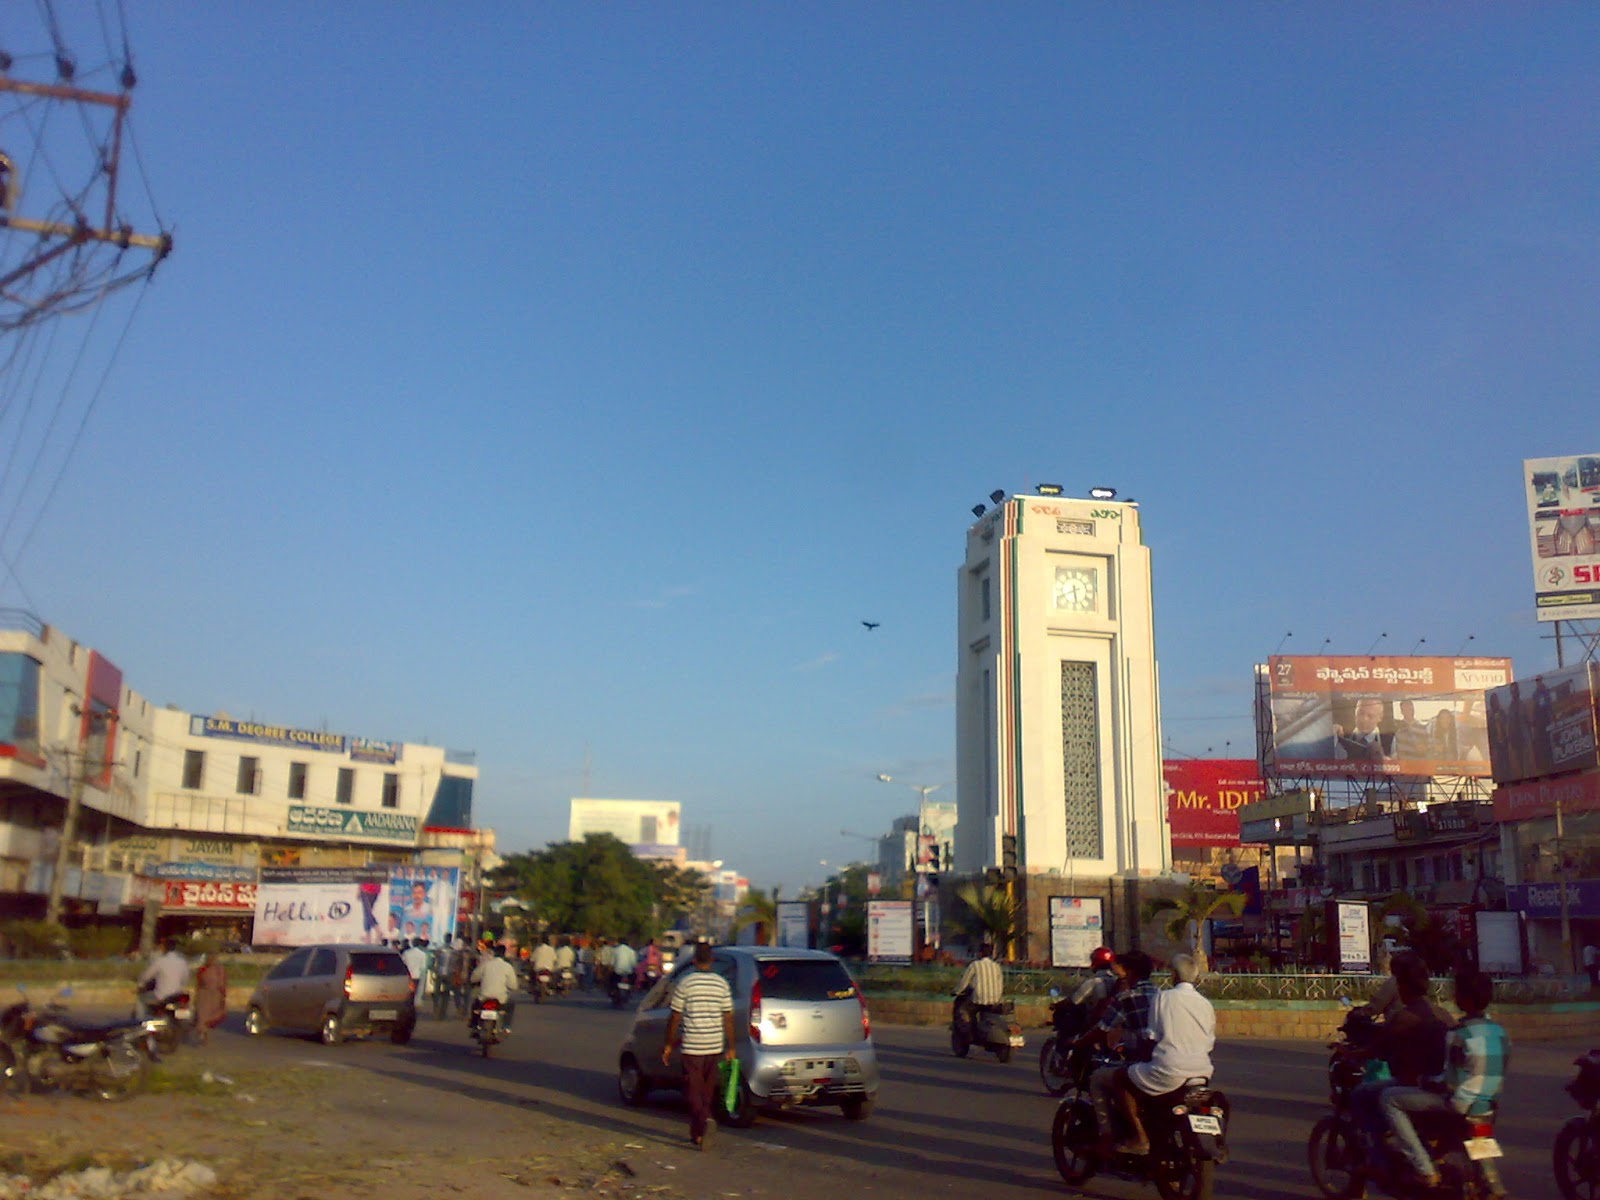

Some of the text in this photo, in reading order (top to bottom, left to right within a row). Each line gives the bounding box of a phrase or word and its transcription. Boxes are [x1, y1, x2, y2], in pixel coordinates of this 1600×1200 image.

[1277, 664, 1292, 676] 27
[206, 719, 233, 733] S.M.
[238, 722, 286, 739] DEGREE
[289, 731, 343, 747] COLLEGE
[1177, 790, 1211, 809] Mr.
[186, 840, 234, 855] JAYAM
